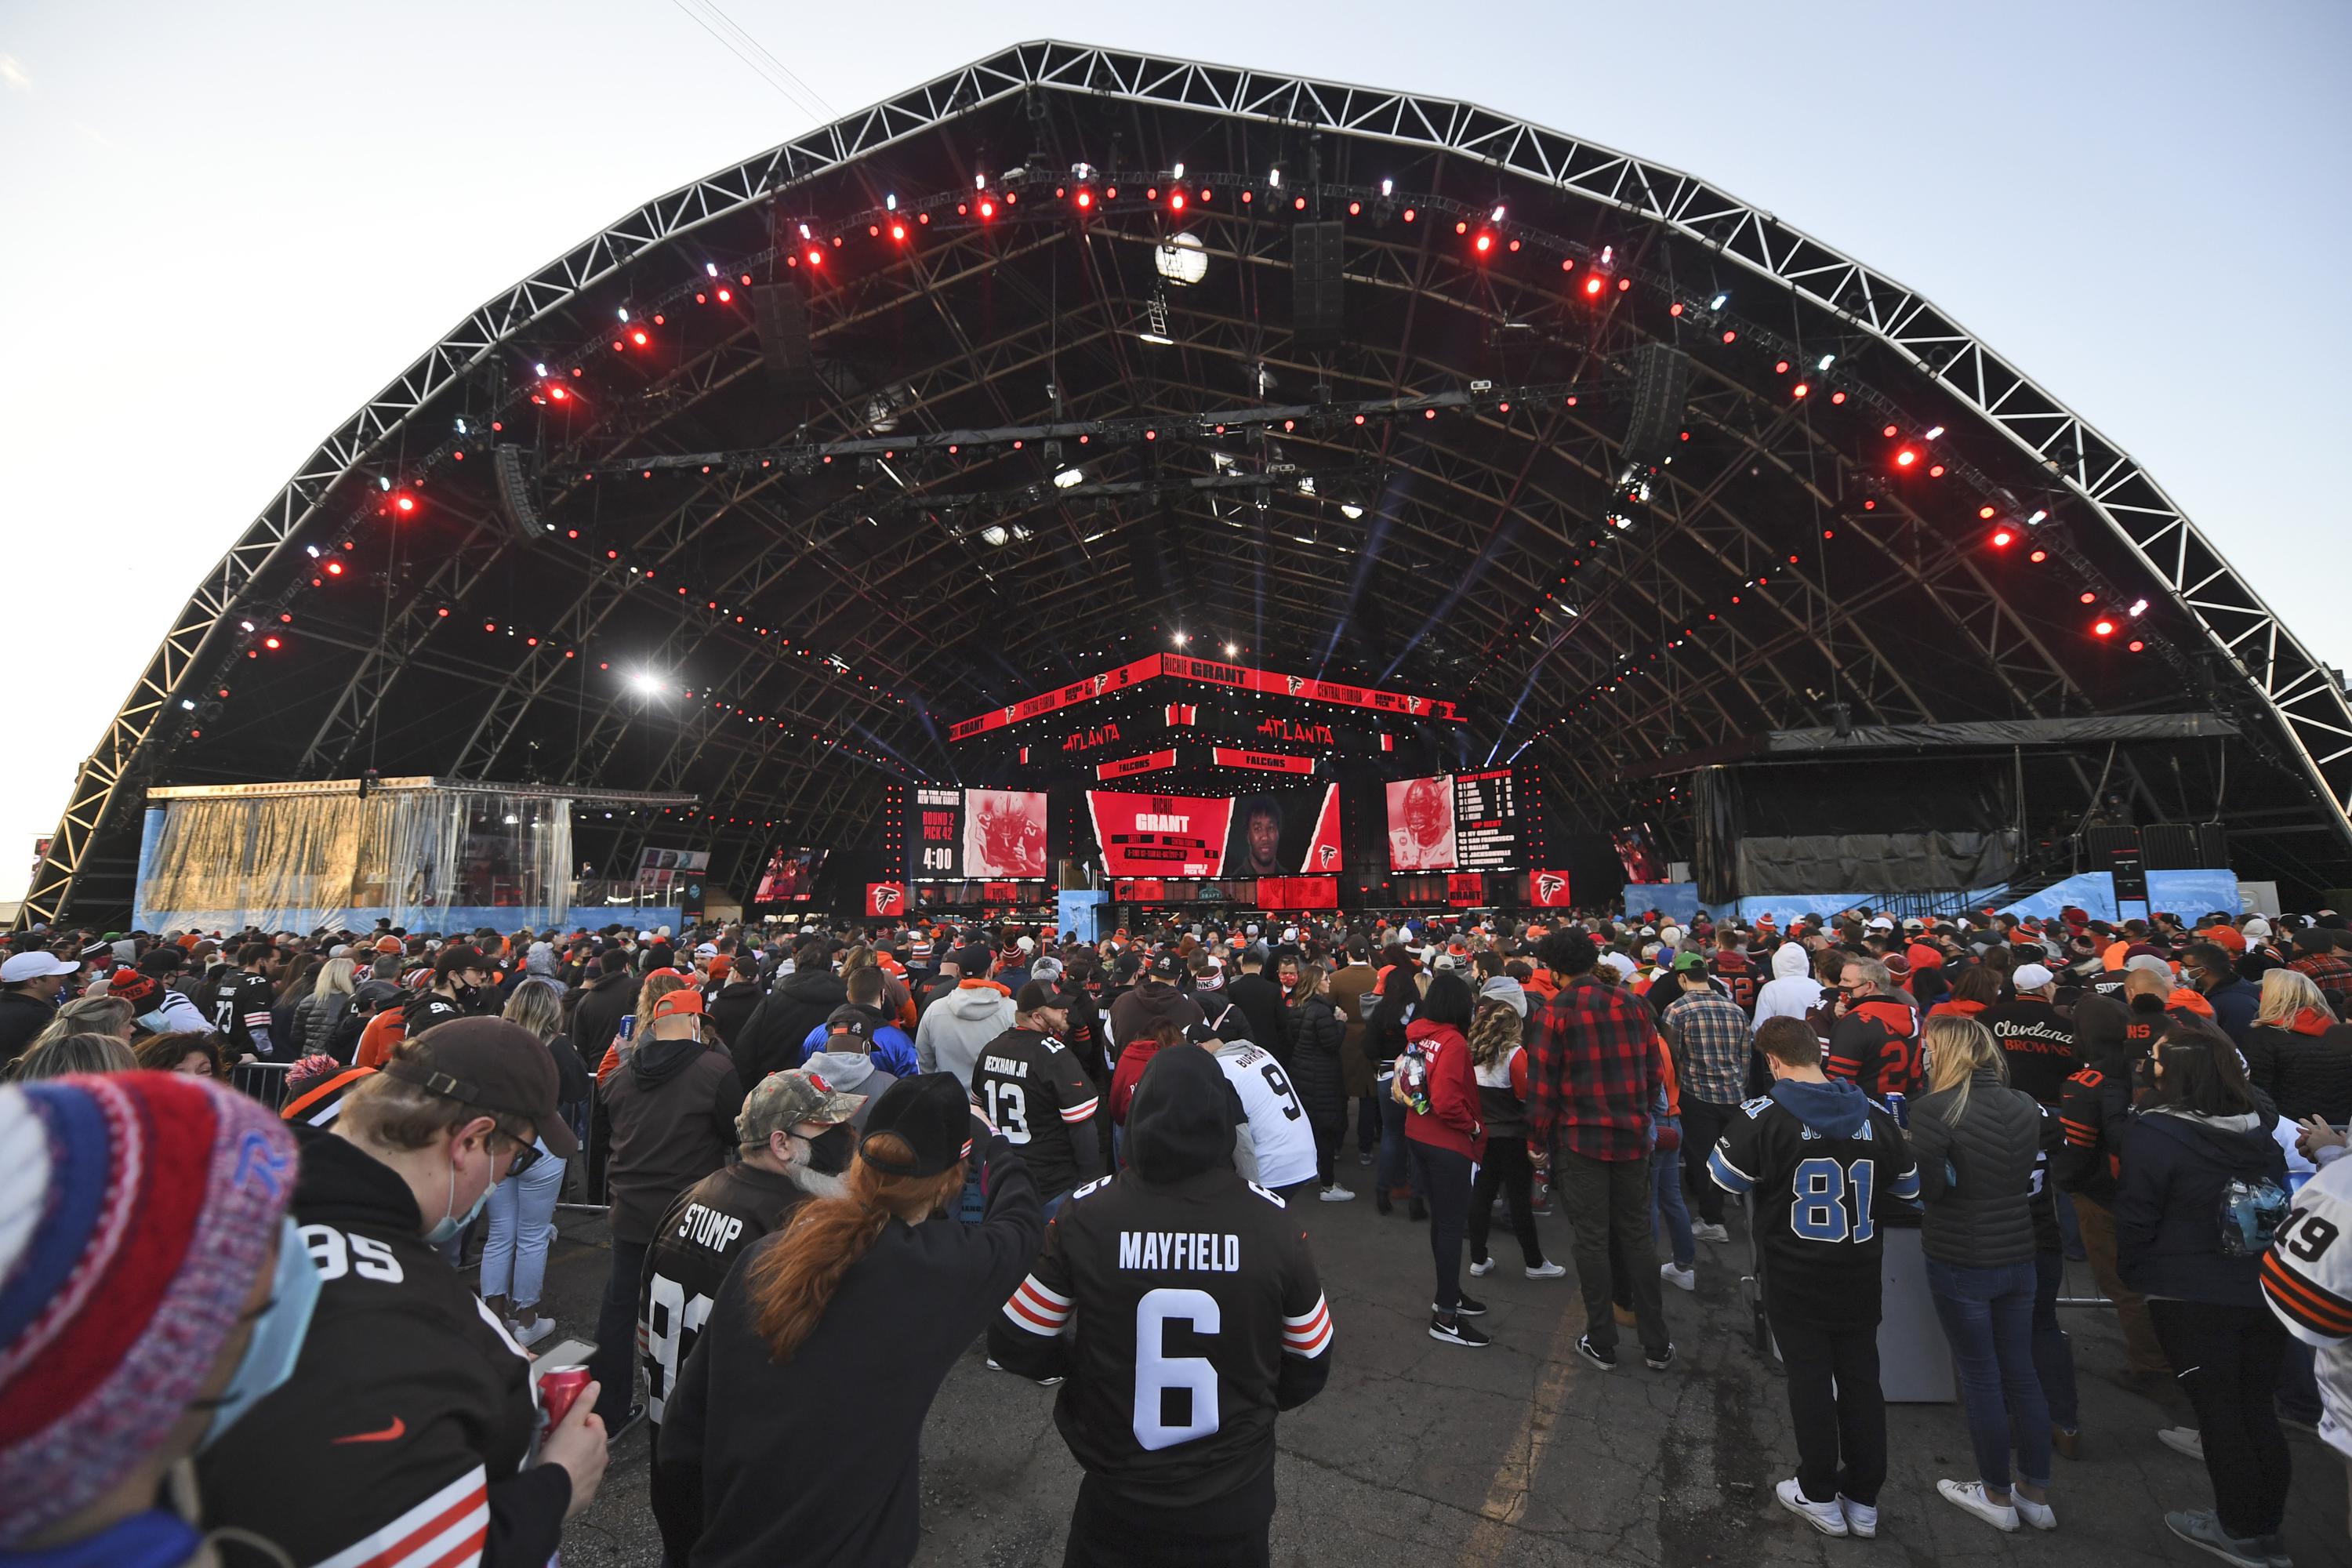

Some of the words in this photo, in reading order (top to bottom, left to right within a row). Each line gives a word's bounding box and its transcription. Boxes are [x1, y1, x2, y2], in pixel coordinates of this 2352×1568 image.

[1191, 661, 1246, 685] GRANT
[1317, 684, 1341, 701] CENTRAL
[960, 718, 984, 735] GRANT
[1257, 718, 1334, 746] ATLANTA
[1062, 723, 1120, 753] ATLANTA
[1119, 759, 1150, 773] FALCONS
[1246, 755, 1286, 768] FALCONS
[929, 796, 942, 804] YORK
[942, 796, 960, 806] GIANTS
[1152, 797, 1173, 814] RICHIE
[923, 811, 948, 826] ROUND
[949, 812, 954, 826] 2
[1136, 813, 1189, 833] GRANT
[924, 826, 941, 840] PICK
[942, 826, 953, 840] 42
[923, 848, 952, 869] 4:00
[216, 1000, 234, 1034] 73
[1041, 1036, 1065, 1054] 13
[2004, 1039, 2072, 1057] BROWNS
[985, 1055, 1016, 1076] BECKHAM
[1016, 1061, 1028, 1078] JR
[1261, 1063, 1301, 1121] 9
[984, 1080, 1032, 1145] 13
[1791, 1157, 1875, 1244] 81
[679, 1203, 743, 1253] STUMP
[2274, 1207, 2339, 1263] 19
[1120, 1232, 1240, 1272] MAYFIELD
[1133, 1288, 1221, 1451] 6
